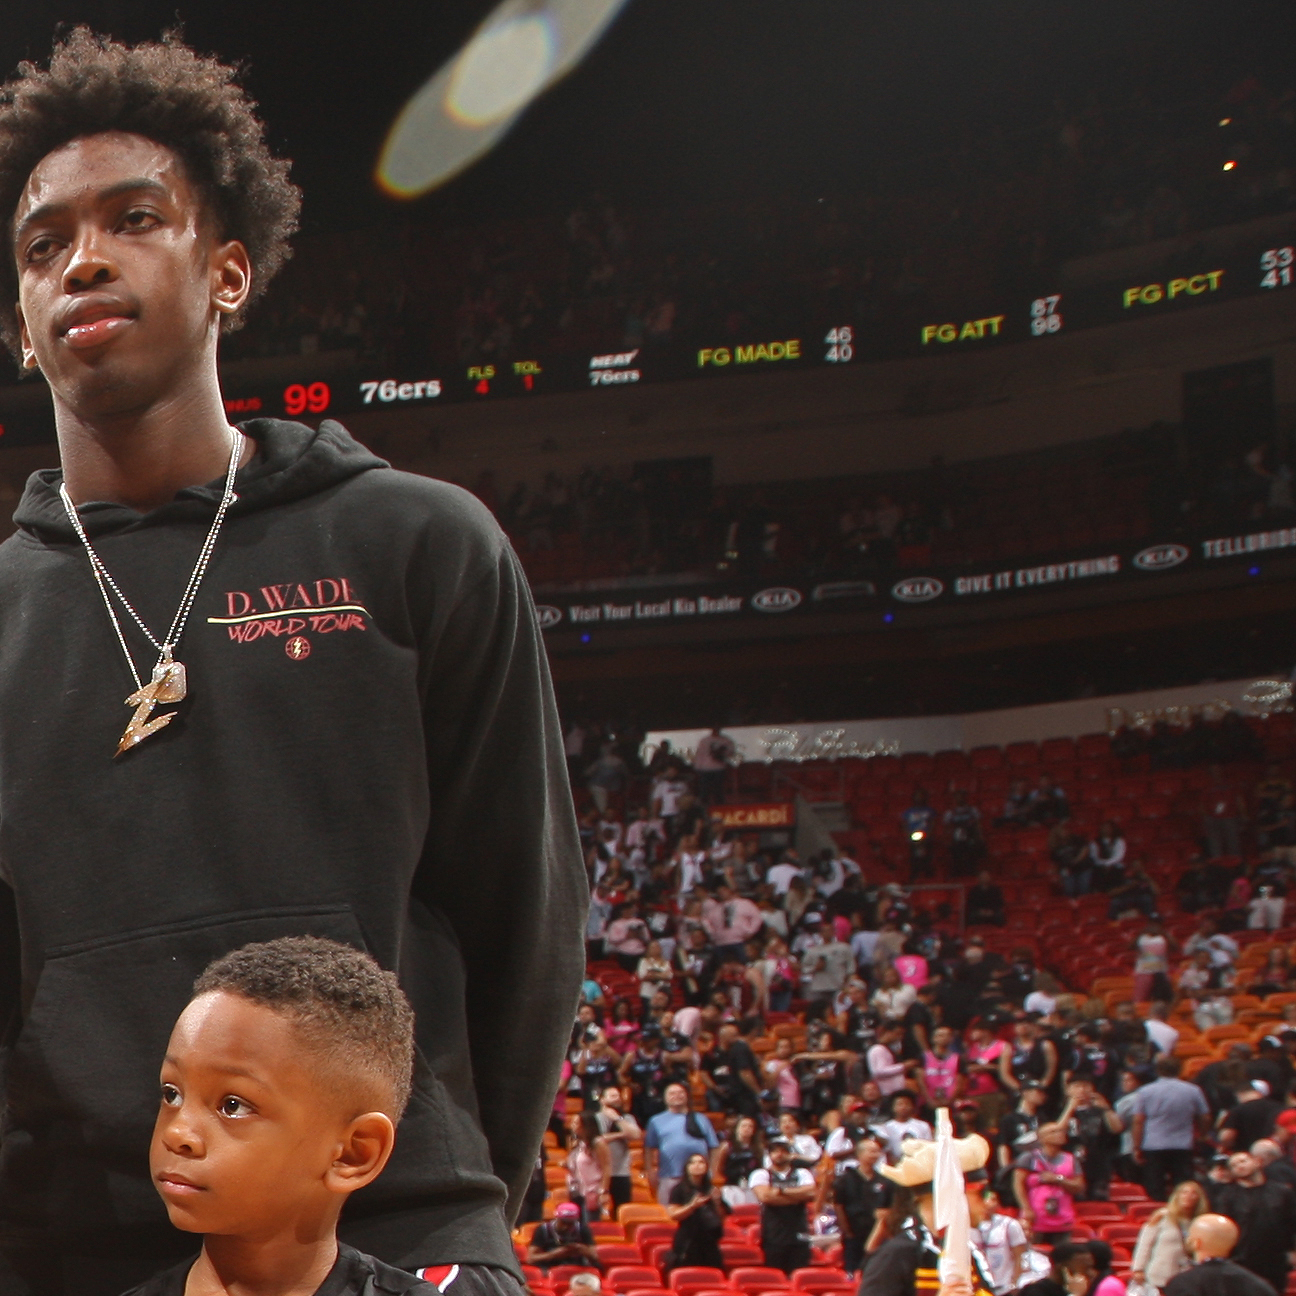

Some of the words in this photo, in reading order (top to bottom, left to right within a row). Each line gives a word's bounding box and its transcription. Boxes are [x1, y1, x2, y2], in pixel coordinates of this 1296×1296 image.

[1261, 247, 1294, 270] 53
[1123, 284, 1163, 308] FG
[1167, 270, 1224, 299] PCT
[1260, 267, 1292, 289] 41
[824, 326, 852, 344] 46
[922, 323, 957, 345] FG
[959, 315, 1005, 341] ATT
[698, 348, 731, 368] FG
[735, 339, 801, 364] MADE
[825, 344, 852, 362] 40
[467, 365, 495, 380] FLS
[513, 361, 542, 376] TOL
[589, 368, 640, 386] 76ers
[475, 379, 489, 395] 4
[523, 374, 533, 391] 1
[284, 382, 331, 415] 99
[360, 379, 442, 404] 76ers
[955, 575, 992, 595] GIVE
[996, 572, 1012, 589] IT
[1016, 556, 1120, 587] EVERYTHING
[225, 591, 256, 616] D.
[569, 605, 600, 623] Visit
[604, 603, 632, 620] Your
[635, 600, 670, 618] Local
[674, 598, 695, 615] Kia
[698, 595, 742, 614] Dealer
[228, 617, 306, 643] WORLD
[309, 613, 366, 633] TOUR
